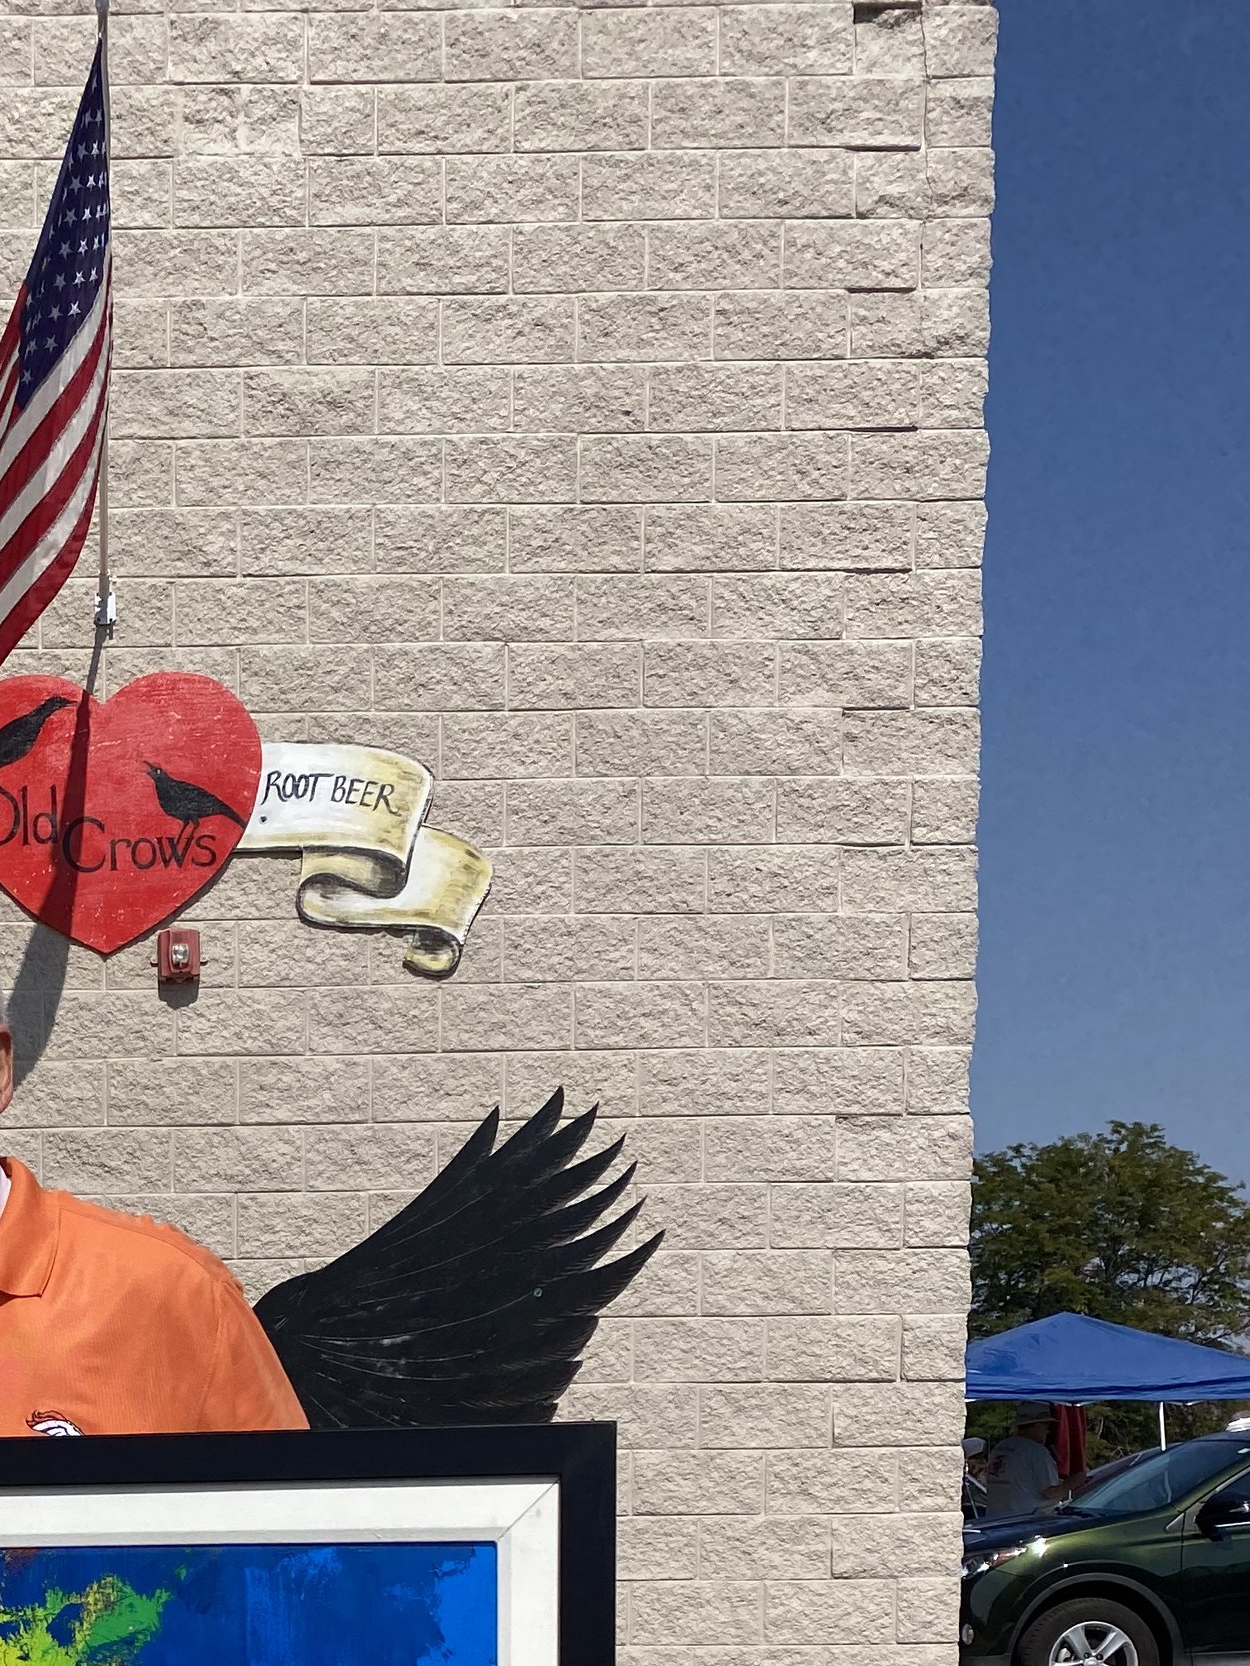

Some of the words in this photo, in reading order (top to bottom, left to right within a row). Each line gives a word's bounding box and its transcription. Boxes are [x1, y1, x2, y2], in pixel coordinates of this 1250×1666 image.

[260, 770, 335, 806] ROOT
[331, 775, 402, 817] BEER
[62, 816, 217, 872] Crows
